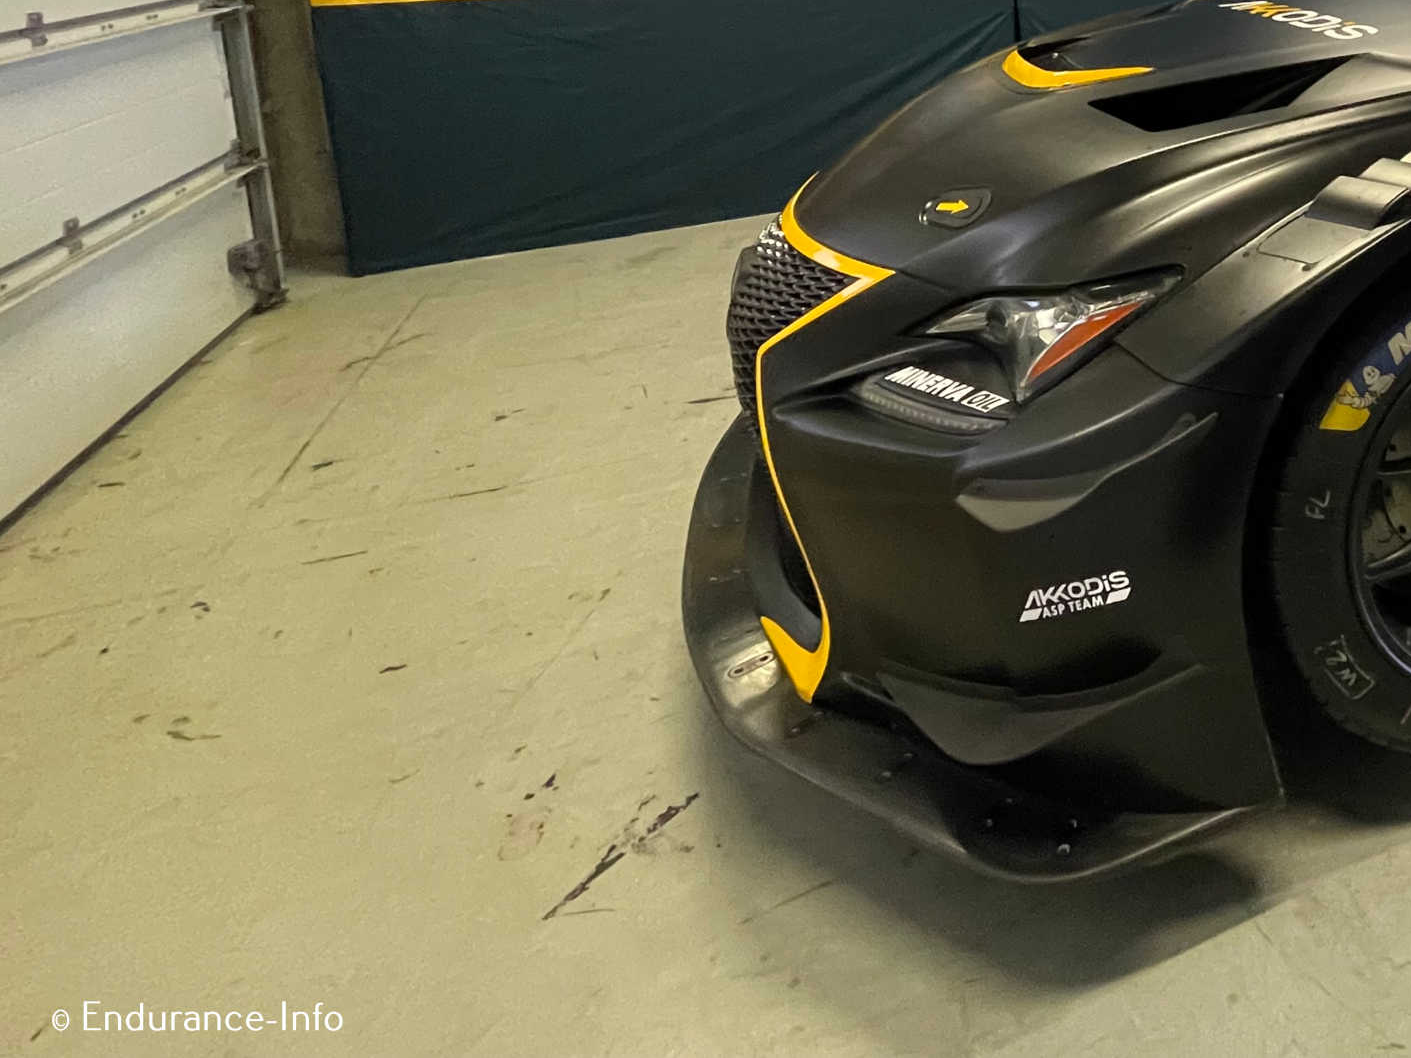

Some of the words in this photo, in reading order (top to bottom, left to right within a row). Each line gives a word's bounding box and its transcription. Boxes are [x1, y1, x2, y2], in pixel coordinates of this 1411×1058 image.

[884, 366, 976, 402] MINERVA
[964, 391, 1007, 413] OIL
[1042, 603, 1066, 618] ASP
[1067, 595, 1104, 613] TEAM
